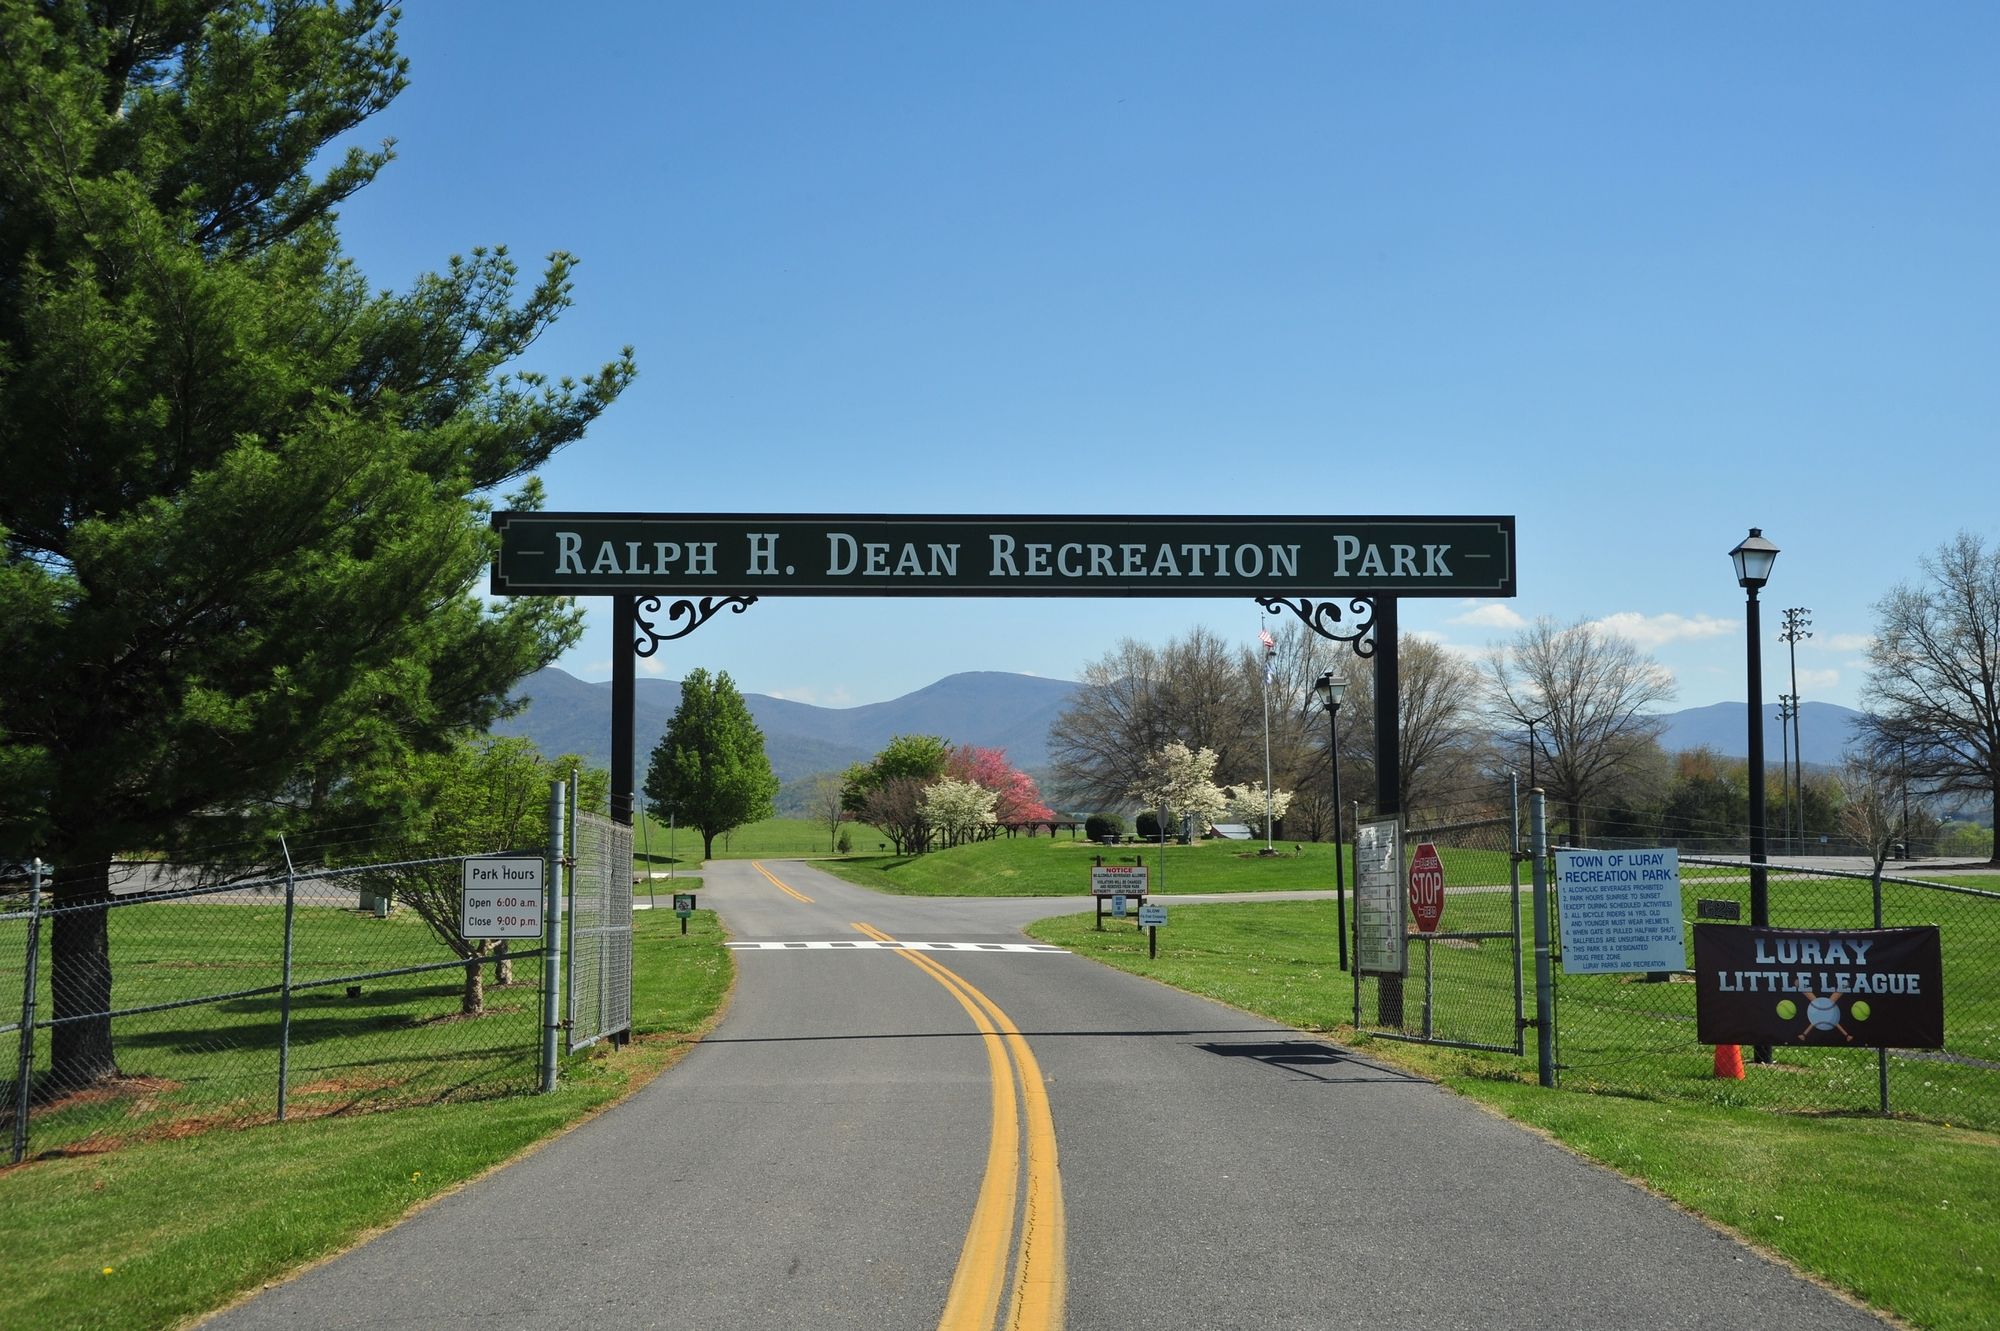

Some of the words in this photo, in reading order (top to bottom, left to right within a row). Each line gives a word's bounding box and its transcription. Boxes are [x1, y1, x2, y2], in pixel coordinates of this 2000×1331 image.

[555, 532, 718, 575] RALPH
[746, 533, 795, 575] H.
[826, 533, 961, 576] DEAN
[989, 534, 1301, 577] RECREATION
[1333, 535, 1453, 577] PARK
[1569, 855, 1602, 867] TOWN
[1608, 855, 1624, 866] OF
[1629, 854, 1664, 866] LURAY
[473, 868, 498, 880] Park
[503, 868, 535, 880] Hours
[1565, 870, 1637, 883] RECREATION
[1642, 869, 1672, 880] PARK
[1411, 872, 1441, 904] STOP
[469, 898, 491, 909] Open
[496, 897, 517, 907] 6:00
[520, 899, 538, 908] a.m.
[1610, 901, 1641, 909] SCHEDULED
[468, 916, 492, 926] Close
[497, 916, 517, 926] 9:00
[520, 918, 538, 927] p.m.
[1618, 935, 1650, 943] UNSUITABLE
[1754, 938, 1874, 966] LURAY
[1718, 971, 1813, 993] LITTLE
[1820, 972, 1921, 995] LEAGUE
